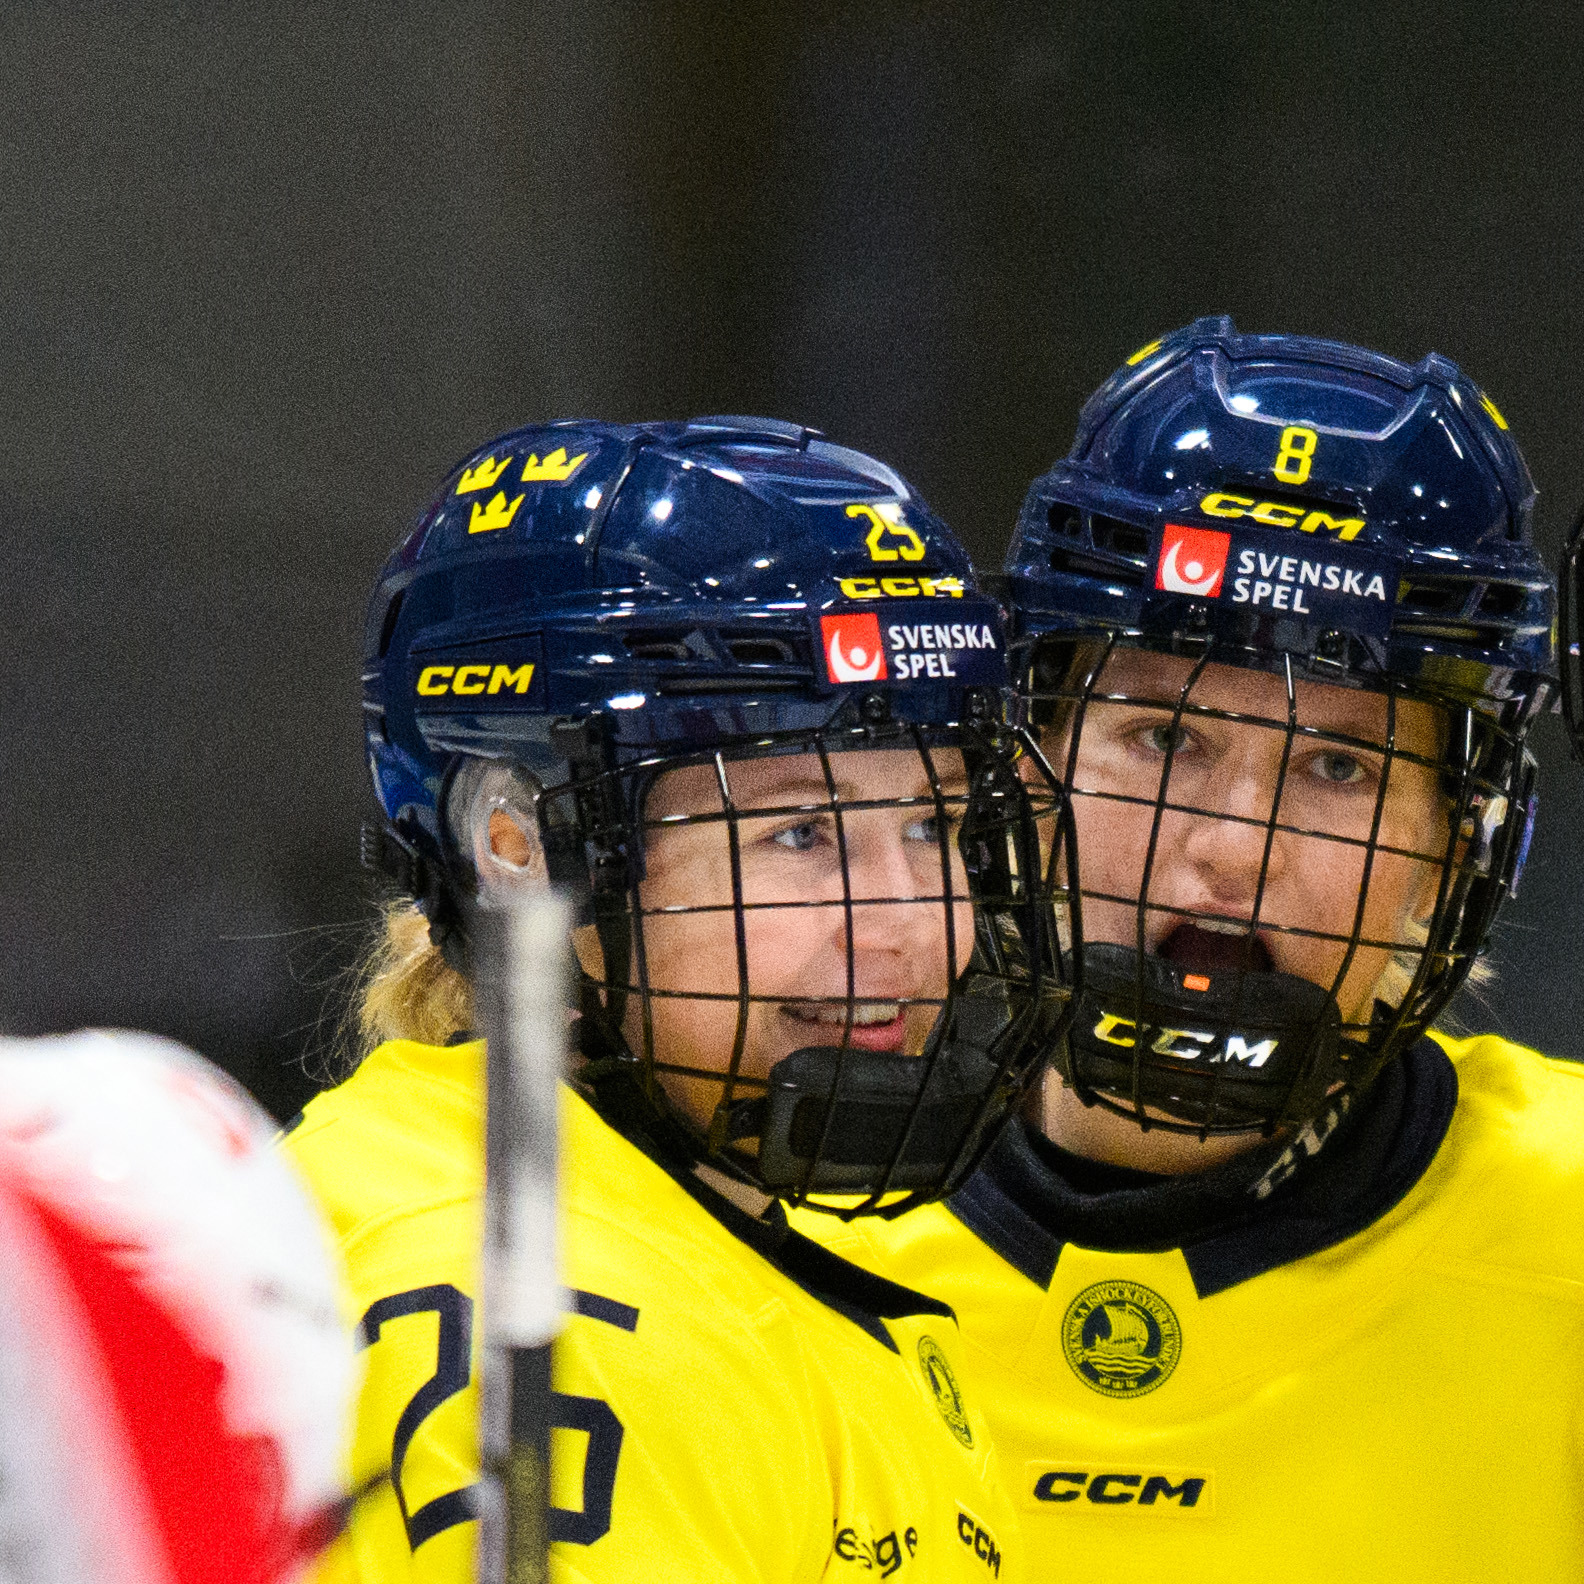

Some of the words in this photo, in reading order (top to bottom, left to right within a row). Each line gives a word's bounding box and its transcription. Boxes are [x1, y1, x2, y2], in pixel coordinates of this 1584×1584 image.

[1273, 426, 1318, 485] 8
[846, 505, 926, 562] 25
[1200, 492, 1366, 541] CCM
[840, 576, 965, 600] CCM
[1237, 550, 1387, 601] SVENSKA
[1232, 578, 1311, 615] SPEL
[888, 624, 996, 651] SVENSKA
[417, 664, 535, 696] CCM
[893, 653, 957, 680] SPEL
[1093, 1012, 1279, 1069] CCM
[1033, 1471, 1207, 1508] CCM
